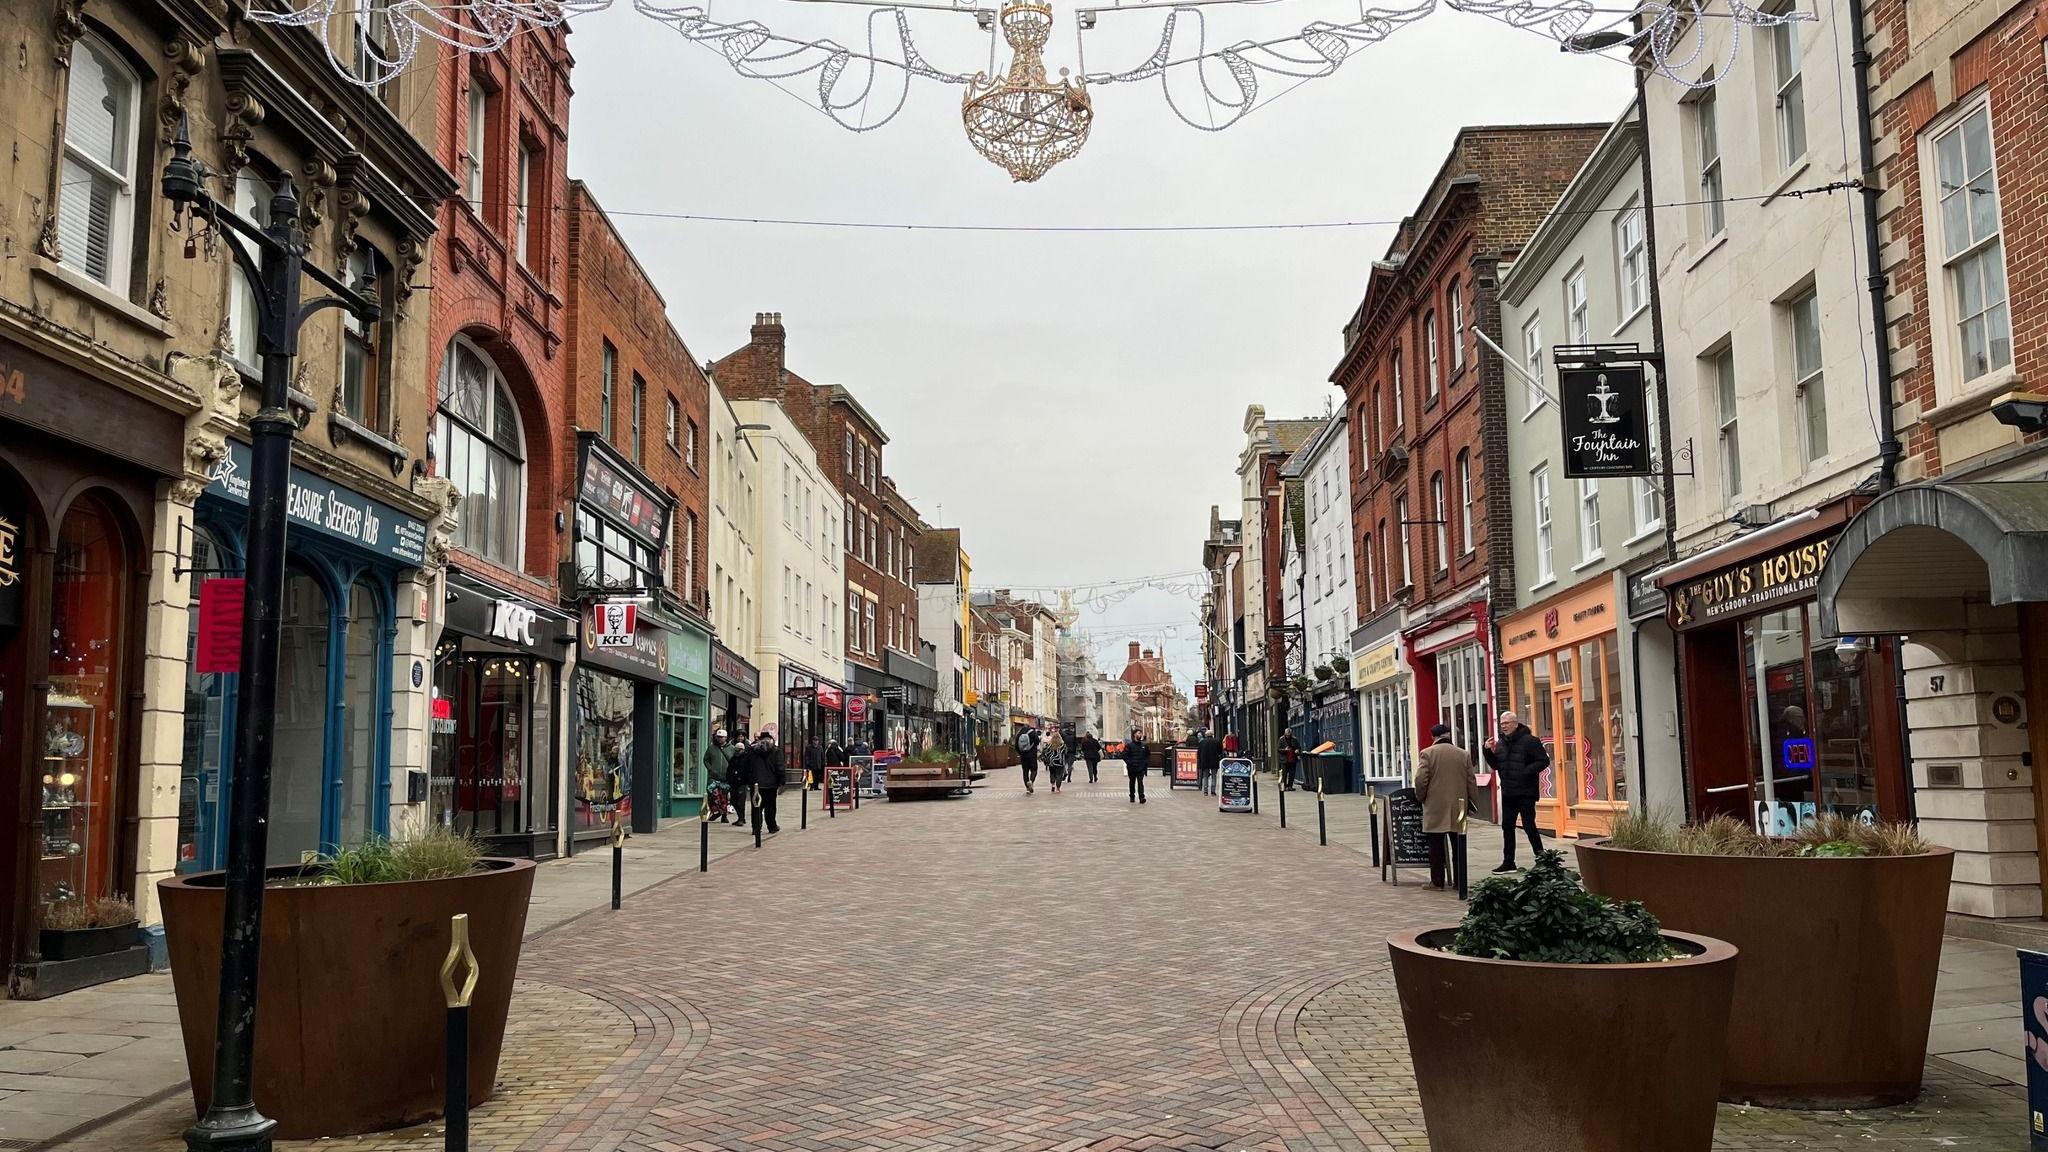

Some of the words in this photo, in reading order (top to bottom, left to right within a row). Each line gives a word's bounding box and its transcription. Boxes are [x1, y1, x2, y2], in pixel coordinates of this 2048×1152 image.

[1572, 434, 1640, 452] Fountain
[1592, 429, 1608, 439] The
[1596, 449, 1619, 462] Inn
[287, 483, 324, 526] EASURE
[1690, 585, 1702, 597] THE
[1702, 566, 1751, 605] GUY'S
[1762, 539, 1829, 588] HOUSE
[1707, 602, 1724, 617] MEN'S
[1725, 598, 1747, 612] GROOM
[1751, 583, 1798, 604] TRADITIONAL
[493, 600, 536, 646] KFC
[602, 636, 628, 644] KFC
[1930, 675, 1945, 692] 57
